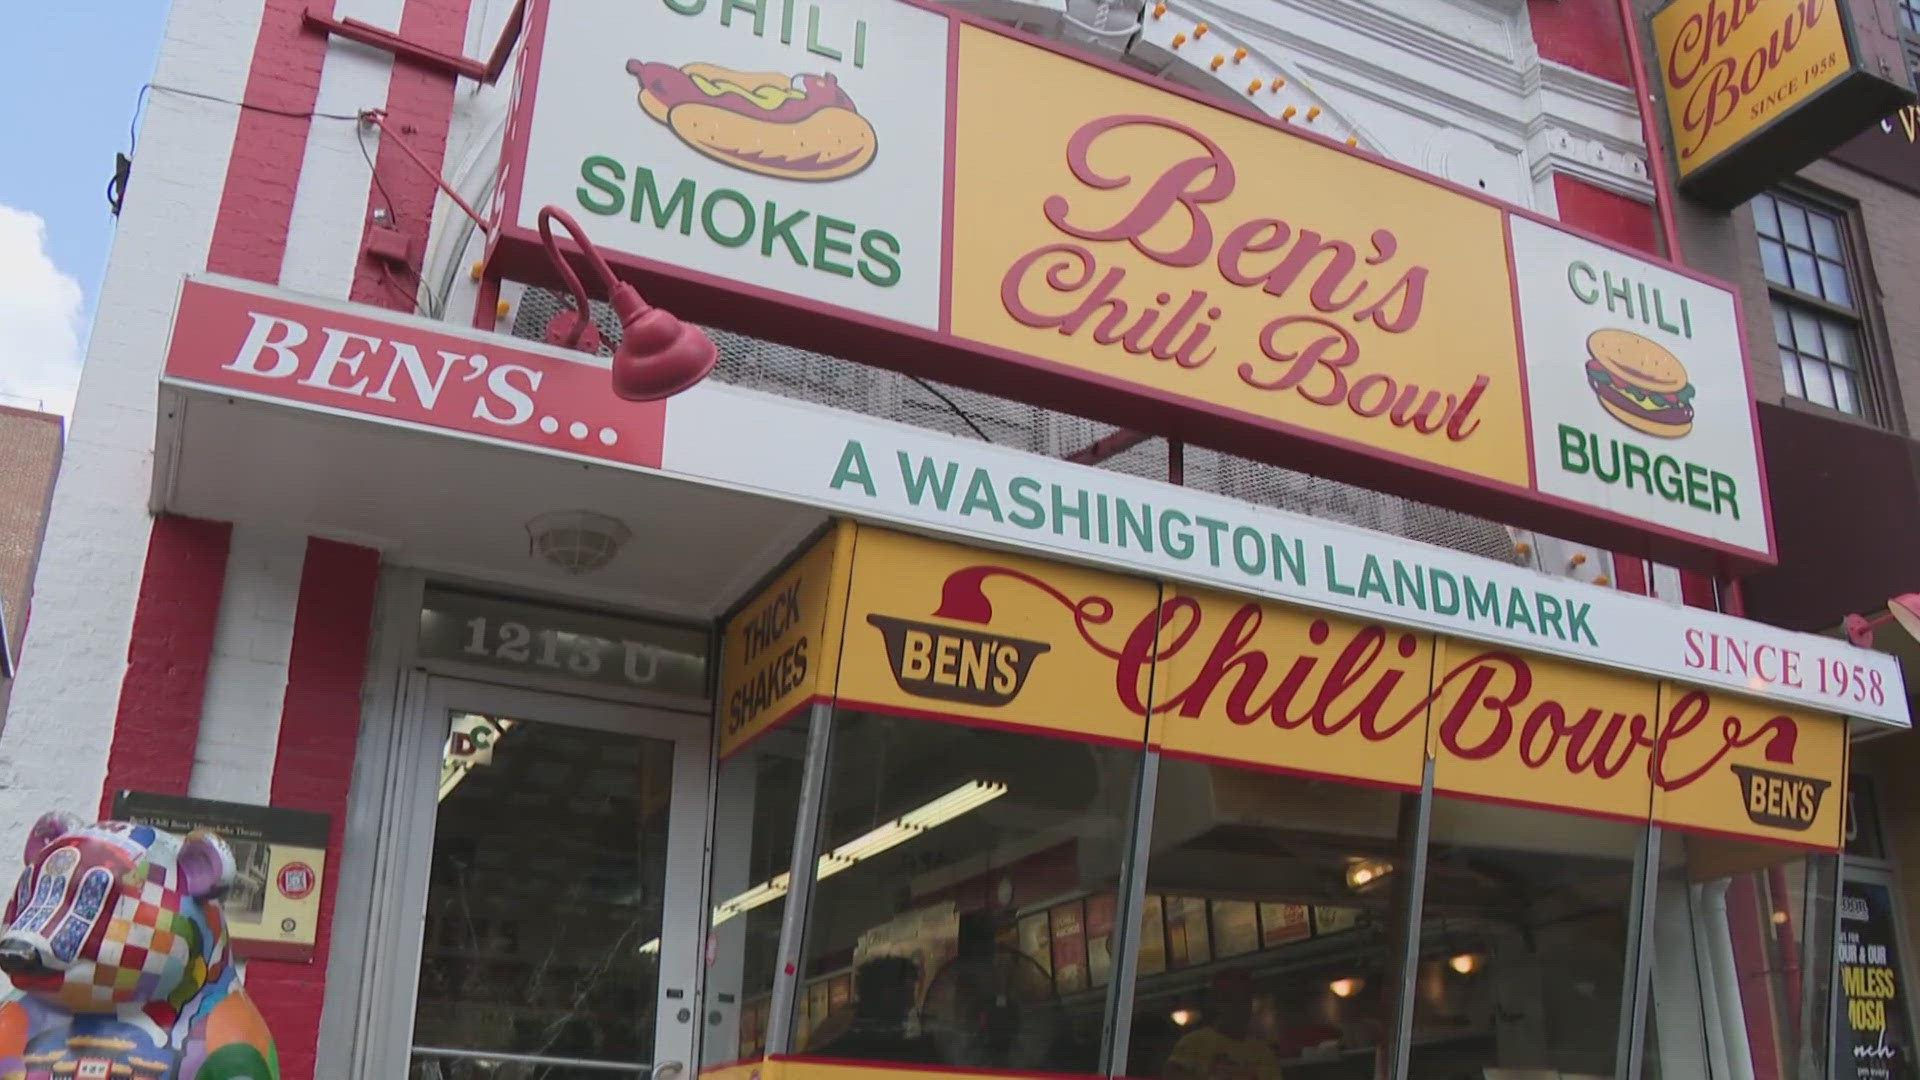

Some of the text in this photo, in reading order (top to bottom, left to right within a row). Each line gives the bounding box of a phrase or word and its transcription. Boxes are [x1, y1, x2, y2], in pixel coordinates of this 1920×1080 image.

[1668, 0, 1758, 90] Chi
[1750, 52, 1837, 121] SINCE 1958
[576, 155, 902, 288] SMOKES
[1043, 114, 1429, 334] Ben's
[1000, 243, 1491, 442] Chili Bowl
[1568, 260, 1693, 340] CHILI
[221, 311, 618, 446] BEN'S...
[1558, 423, 1740, 521] BURGER
[829, 439, 1600, 648] A WASHINGTON LANDMARK
[464, 616, 662, 683] 1213 U
[743, 577, 802, 666] THICK
[901, 628, 1021, 696] BEN'S
[728, 635, 808, 736] SHAKES
[1110, 595, 1714, 792] Chili Bowl
[1684, 627, 1886, 708] SINCE 1958
[450, 724, 493, 756] DC
[1750, 774, 1816, 825] BEN'S
[1867, 944, 1887, 965] OUR
